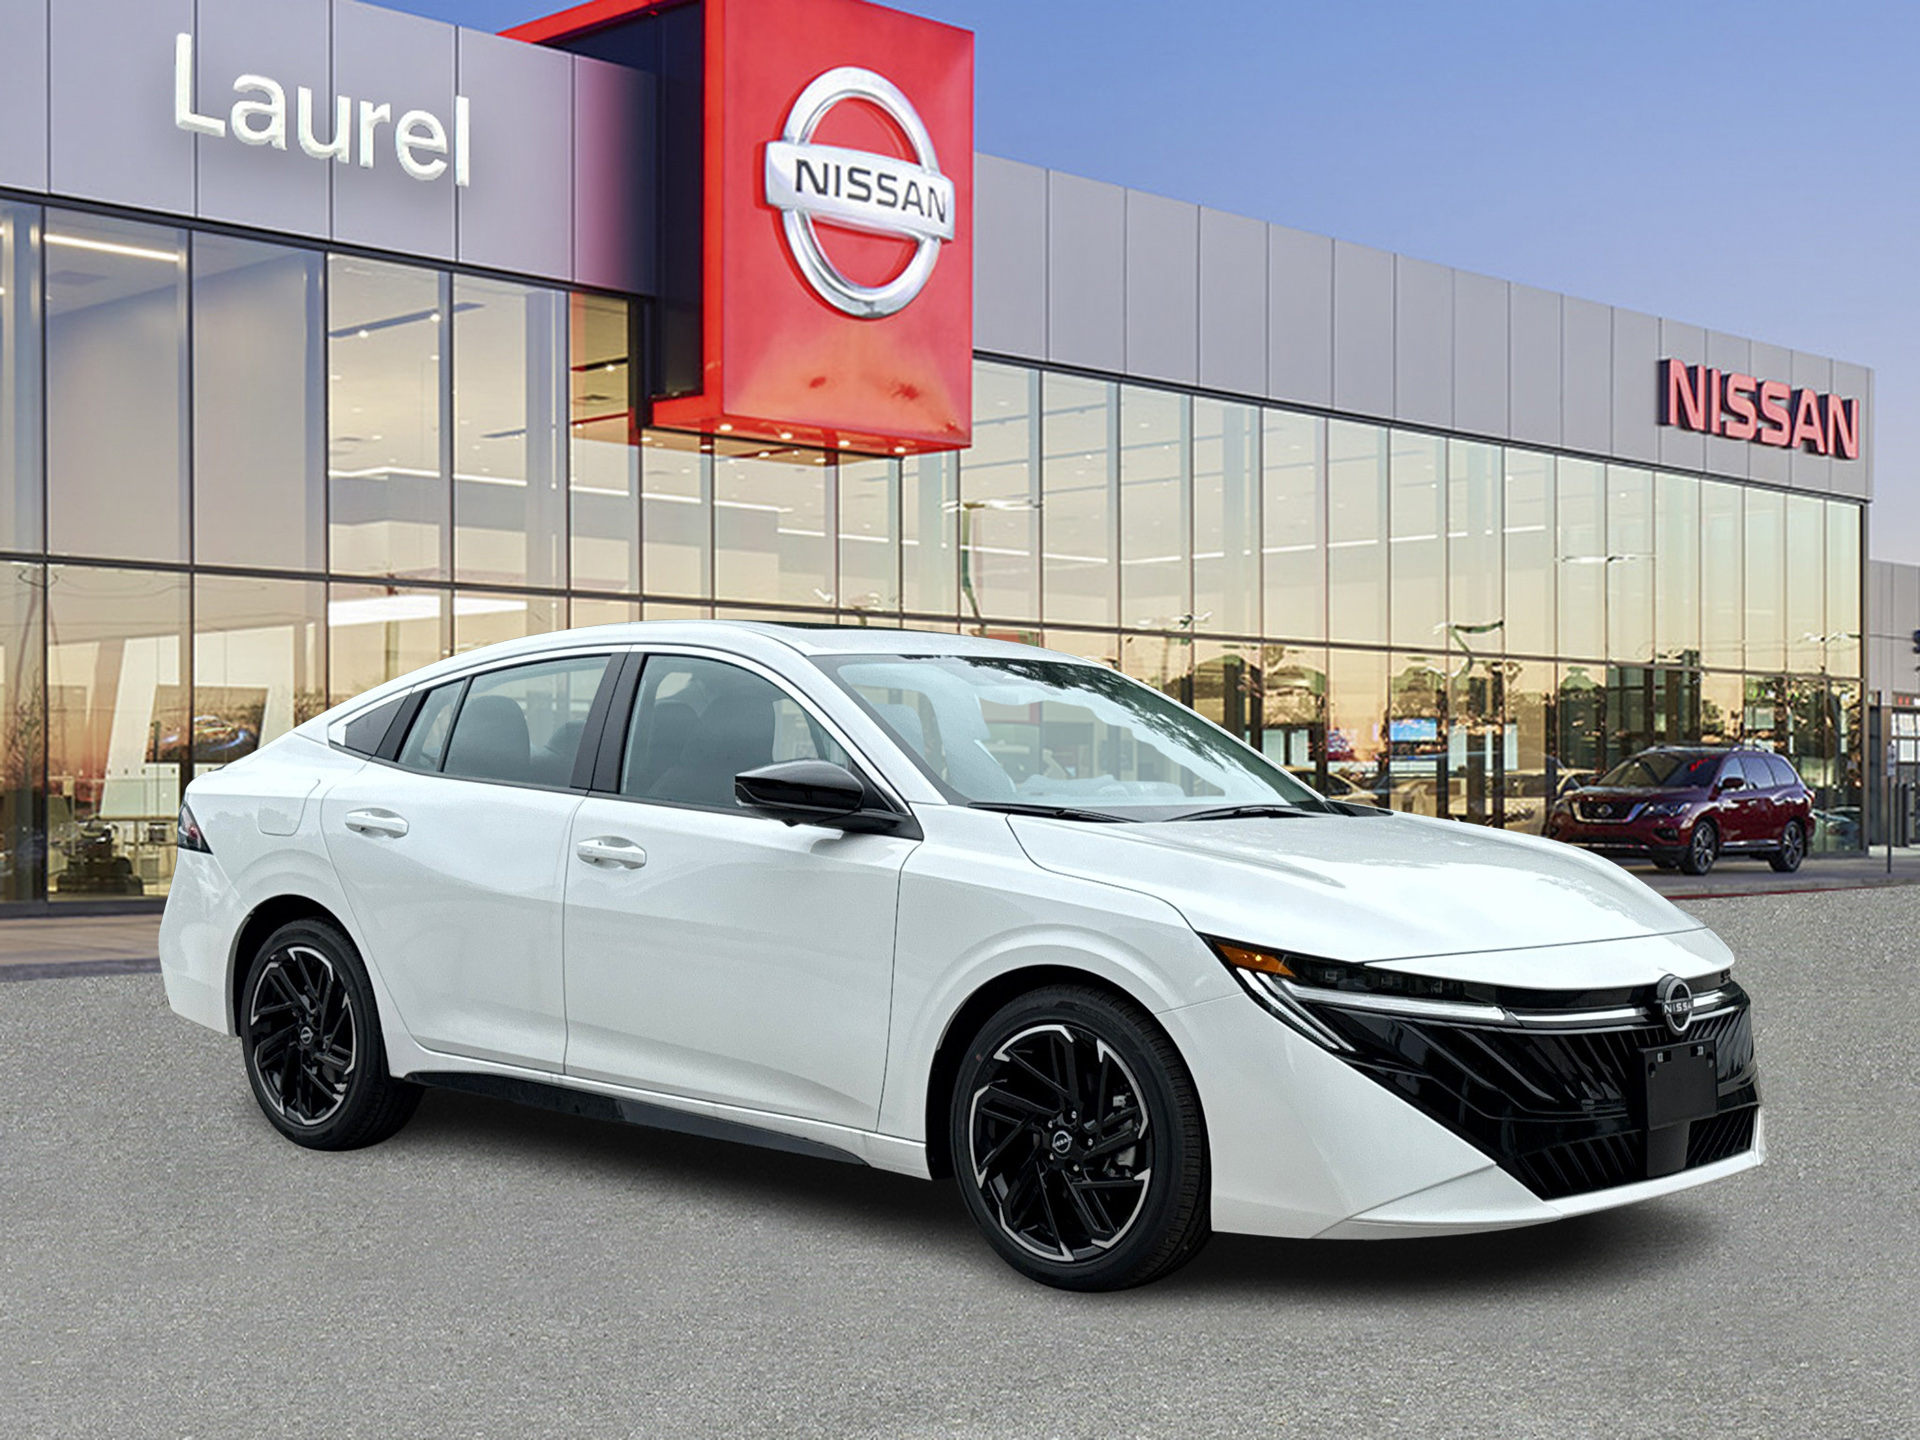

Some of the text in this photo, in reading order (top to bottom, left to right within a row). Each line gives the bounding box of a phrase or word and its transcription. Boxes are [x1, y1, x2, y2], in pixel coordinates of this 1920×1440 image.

[175, 33, 470, 188] Laurel
[795, 158, 947, 223] NISSAN
[1660, 358, 1860, 460] NISSAN
